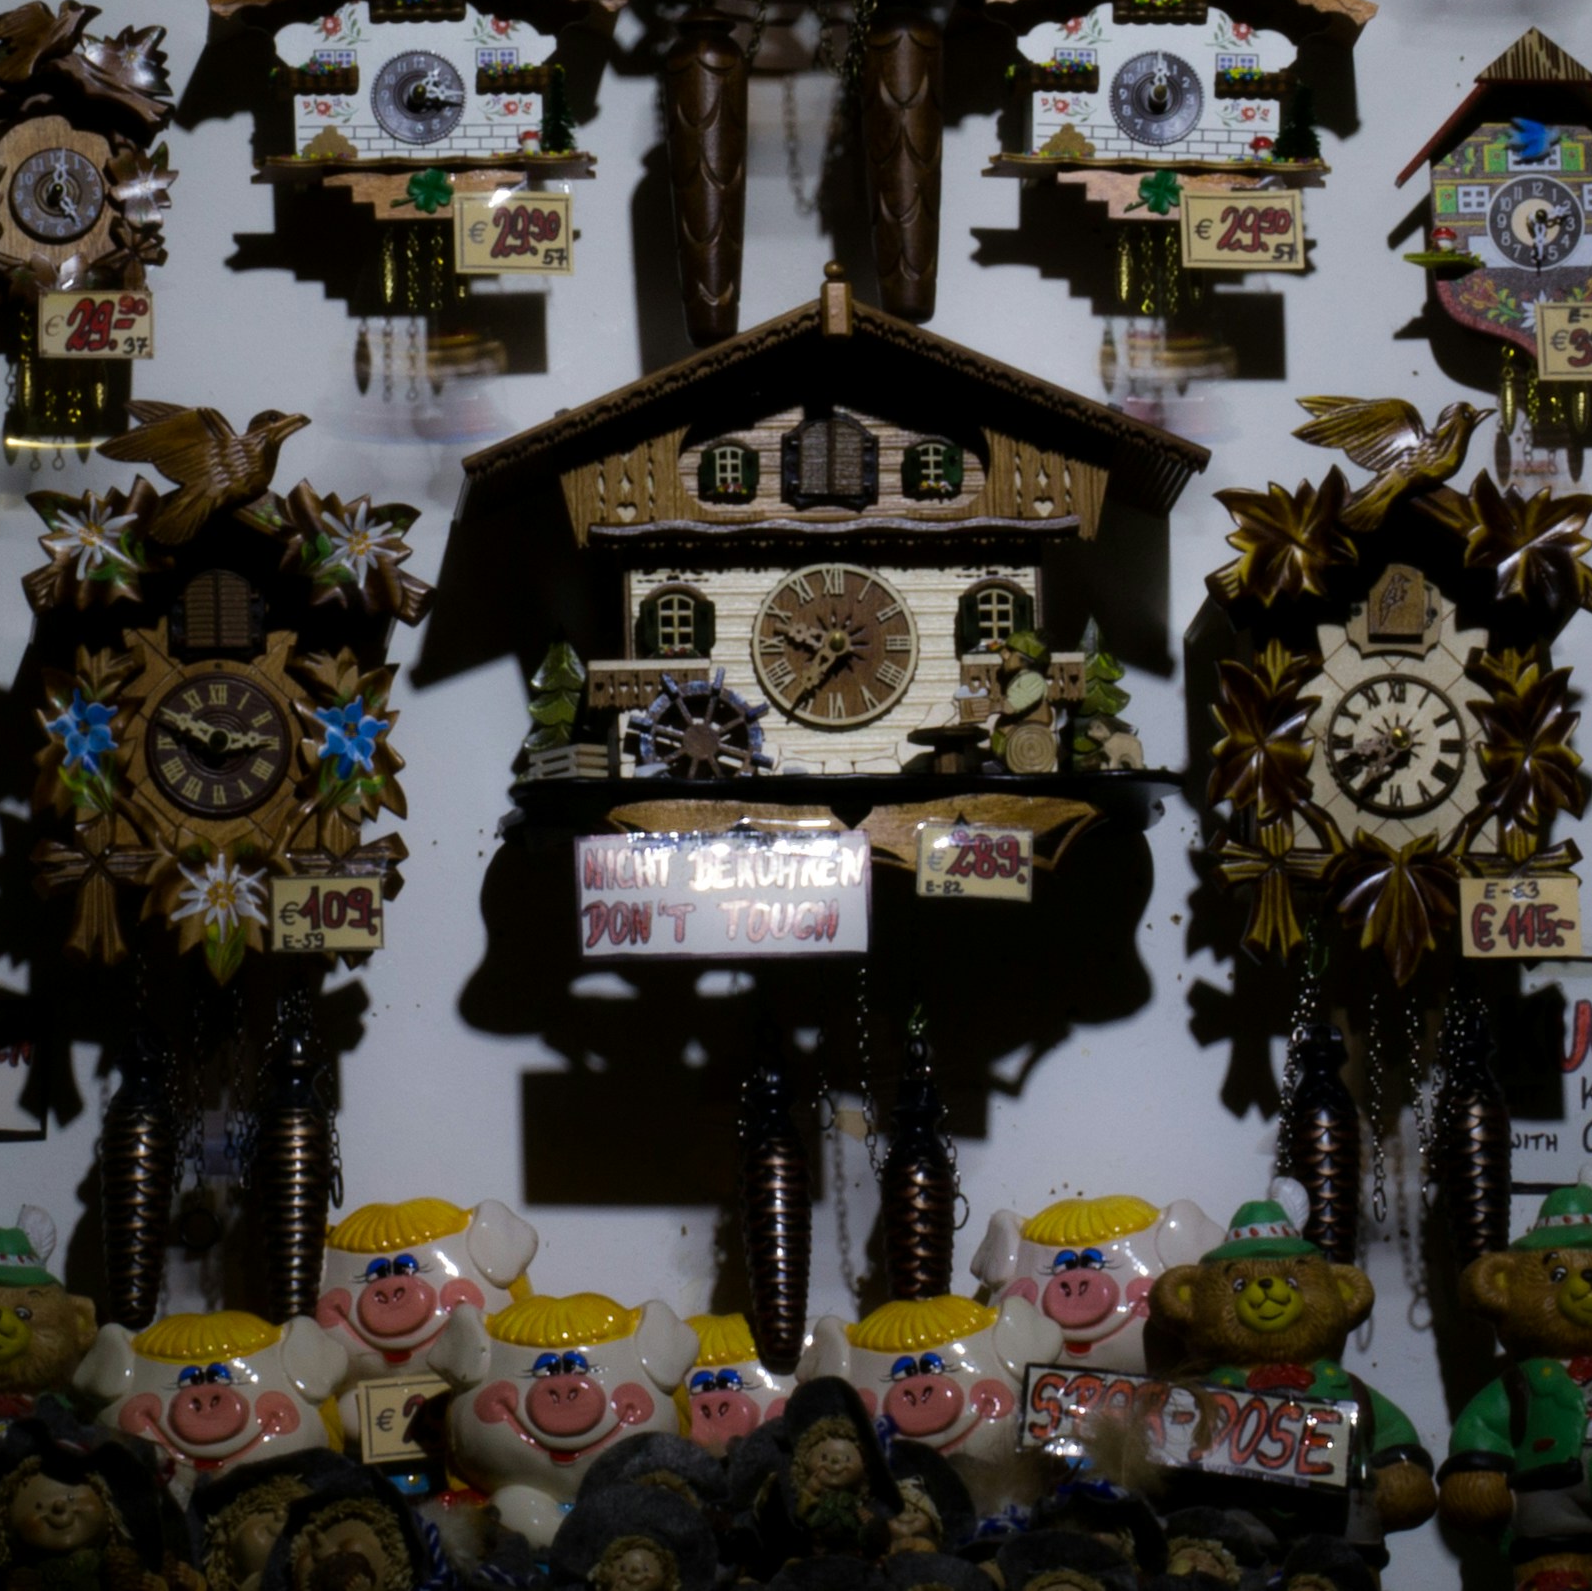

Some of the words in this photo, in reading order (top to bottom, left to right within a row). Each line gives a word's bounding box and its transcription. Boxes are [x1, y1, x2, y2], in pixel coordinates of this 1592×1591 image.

[468, 221, 487, 244] €
[1195, 219, 1213, 240] €
[542, 248, 567, 265] 57
[45, 316, 64, 336] €
[123, 337, 148, 353] 37
[1551, 330, 1569, 351] €
[584, 847, 671, 890] NICHT
[927, 853, 946, 872] €
[279, 902, 299, 926] €
[583, 900, 694, 948] DON'T
[719, 899, 839, 942] TOUCH
